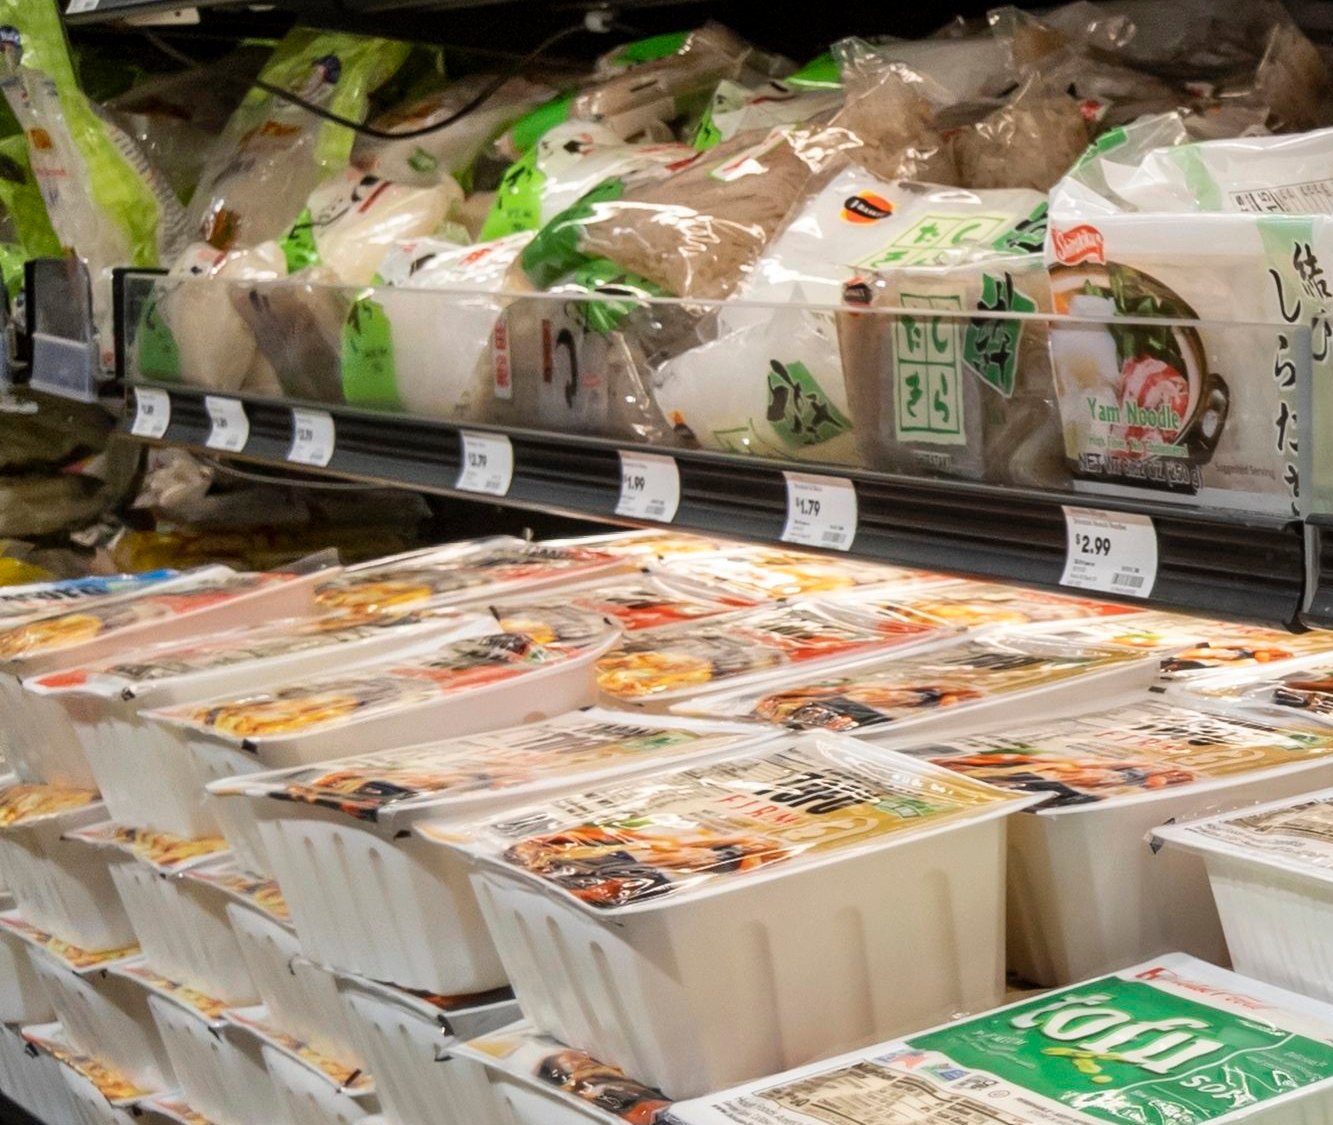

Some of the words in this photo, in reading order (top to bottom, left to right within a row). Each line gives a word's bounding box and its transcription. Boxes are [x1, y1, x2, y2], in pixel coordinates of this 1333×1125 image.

[1088, 397, 1119, 425] Yam
[1127, 402, 1180, 430] Noodle
[1075, 532, 1111, 556] $2.99
